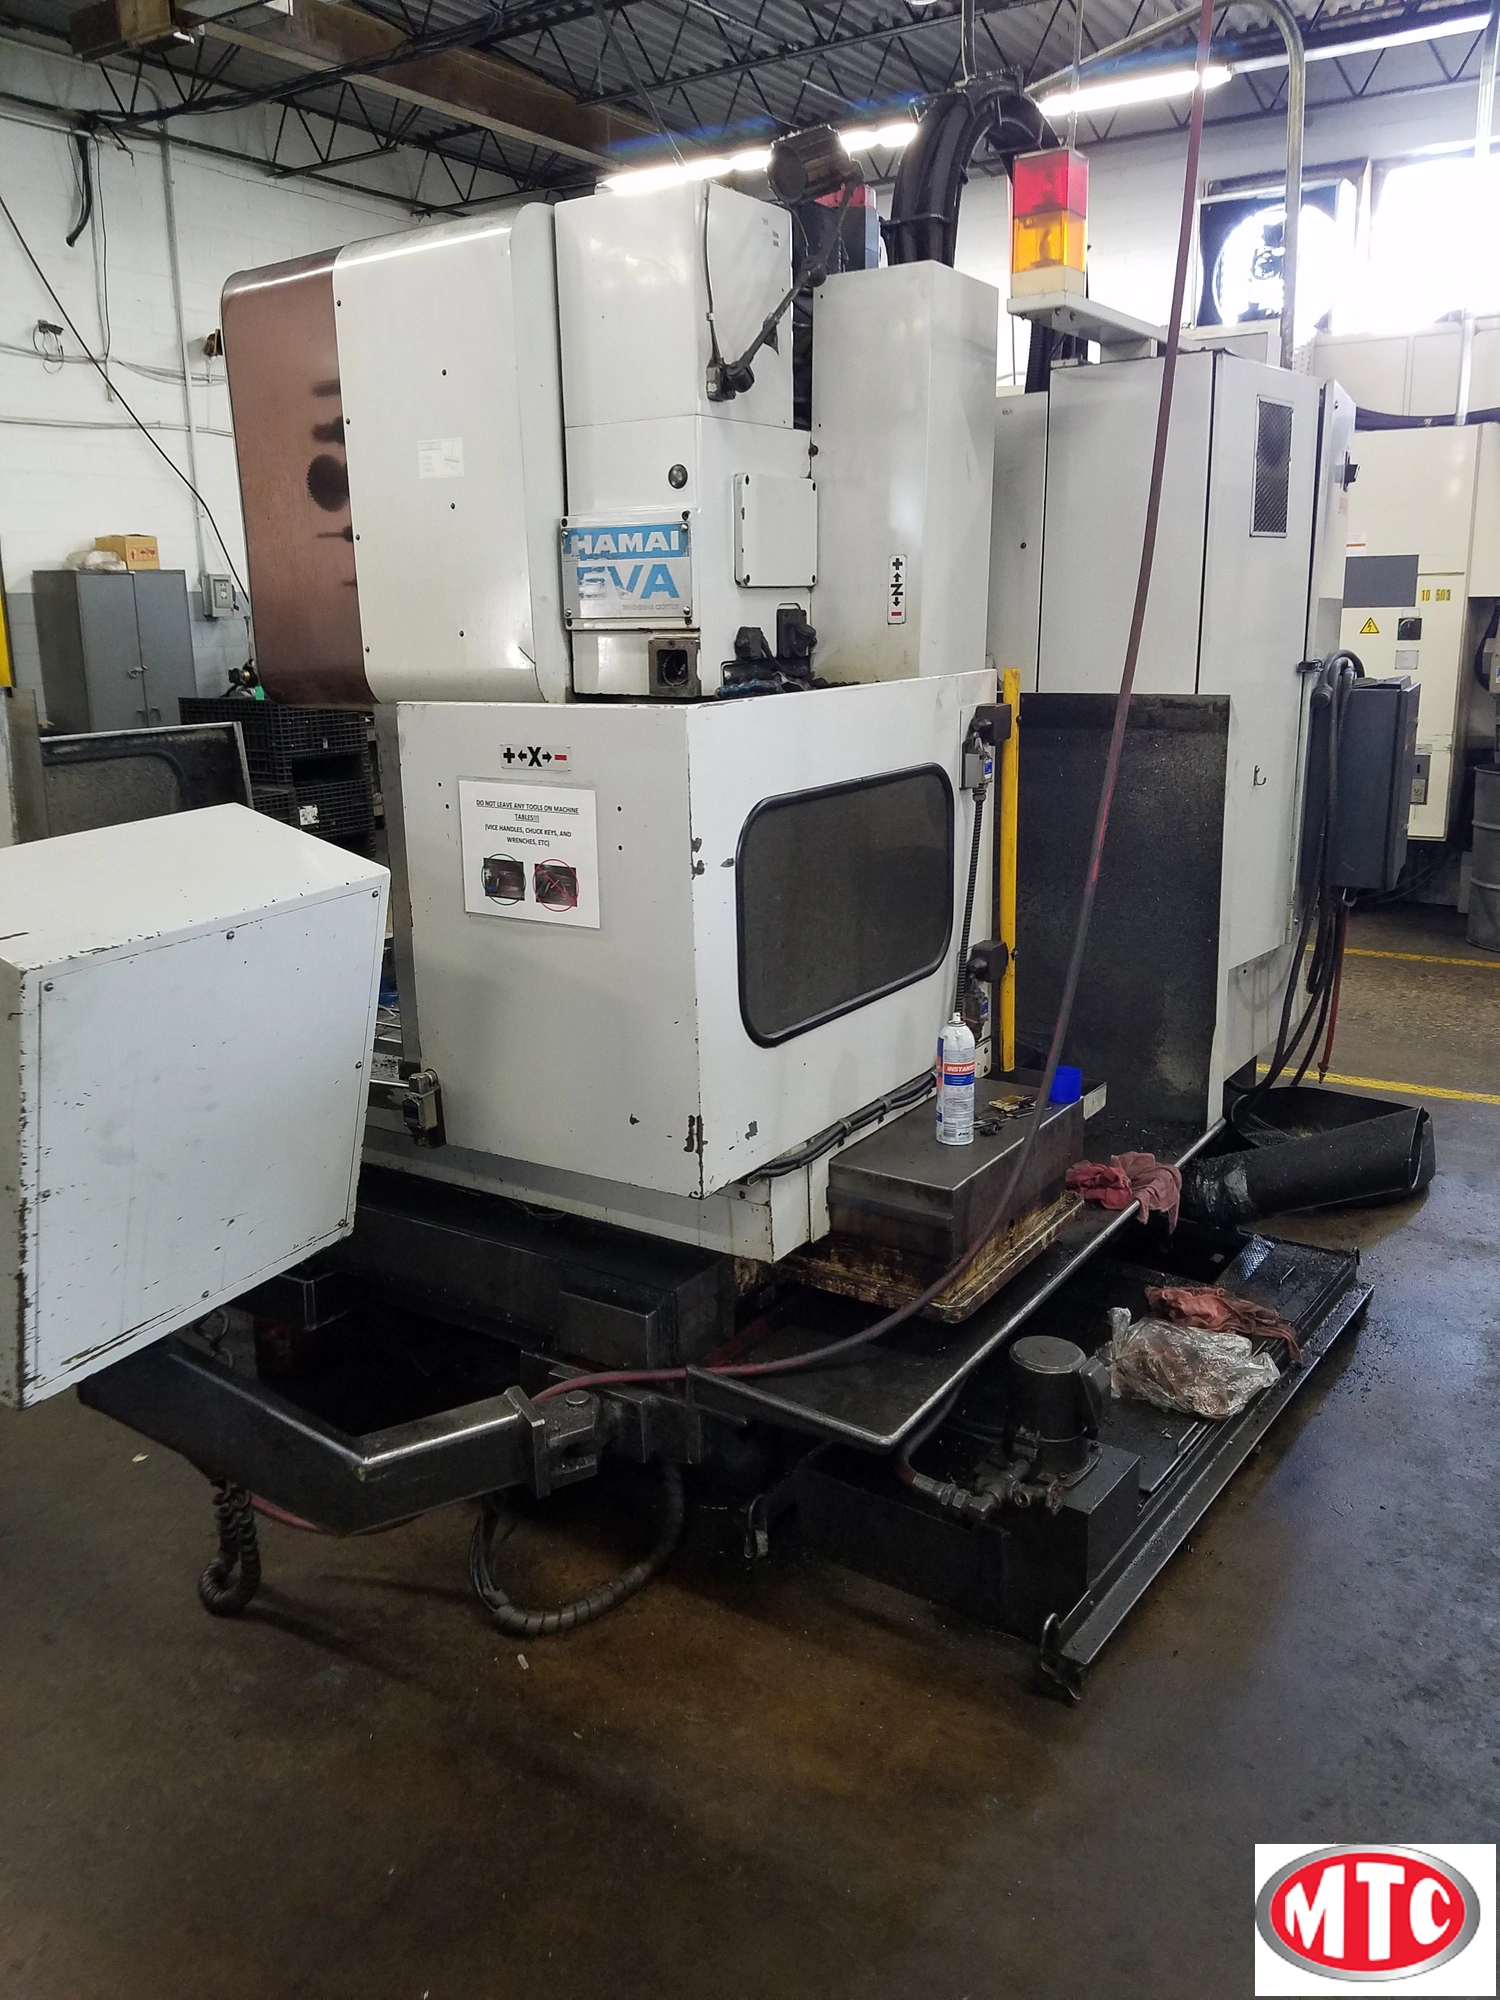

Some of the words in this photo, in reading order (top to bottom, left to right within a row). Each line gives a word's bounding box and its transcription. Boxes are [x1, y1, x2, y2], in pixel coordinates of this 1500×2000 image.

[570, 530, 680, 555] HAMAI
[890, 583, 904, 597] Z
[526, 746, 543, 767] X
[476, 799, 484, 807] DO
[497, 801, 512, 809] LEAVE
[526, 803, 543, 812] TOOLS
[553, 805, 579, 813] MACHINE
[485, 823, 498, 831] (VICE
[498, 824, 524, 834] HANDLES,
[525, 827, 543, 835] CHUCK
[544, 829, 559, 838] KEYS,
[560, 830, 572, 838] AND
[506, 836, 537, 846] WRENCHES,
[538, 839, 550, 847] ETC)
